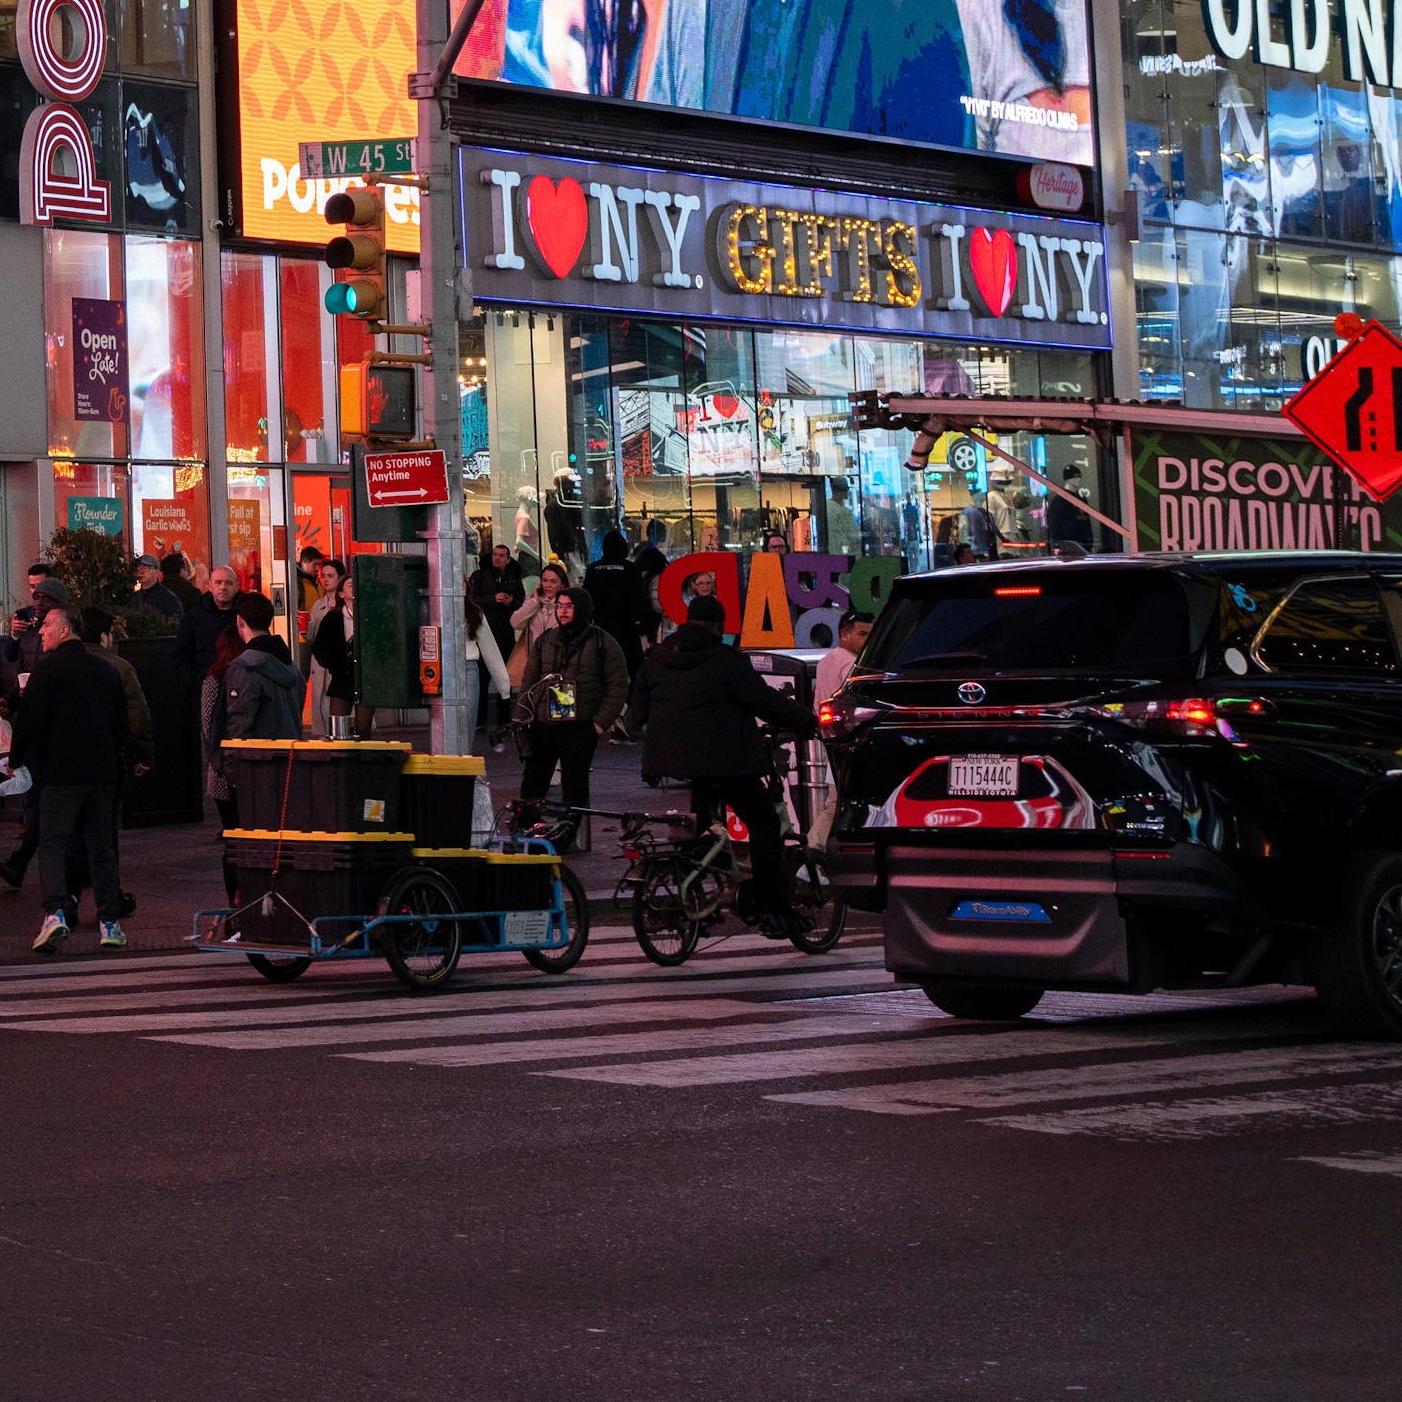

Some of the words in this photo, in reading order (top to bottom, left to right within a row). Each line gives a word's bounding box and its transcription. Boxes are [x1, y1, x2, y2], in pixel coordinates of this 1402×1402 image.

[991, 101, 1005, 119] BY
[1004, 102, 1047, 126] ALFREDO
[327, 148, 347, 175] W
[360, 144, 386, 172] 45
[396, 141, 410, 161] St
[1034, 164, 1080, 200] Heritage
[723, 202, 922, 307] GIFTS
[80, 328, 117, 353] Open
[88, 351, 120, 385] Late!
[815, 419, 847, 430] Subway
[369, 459, 384, 470] NO
[385, 456, 432, 470] STOPPING
[371, 470, 411, 483] Anytime
[74, 502, 118, 522] Flounder
[150, 505, 186, 518] Louisiana
[230, 506, 243, 518] Fall
[244, 506, 255, 518] at
[145, 518, 169, 532] Garlic
[238, 522, 252, 536] sip
[955, 765, 1012, 786] T115444C
